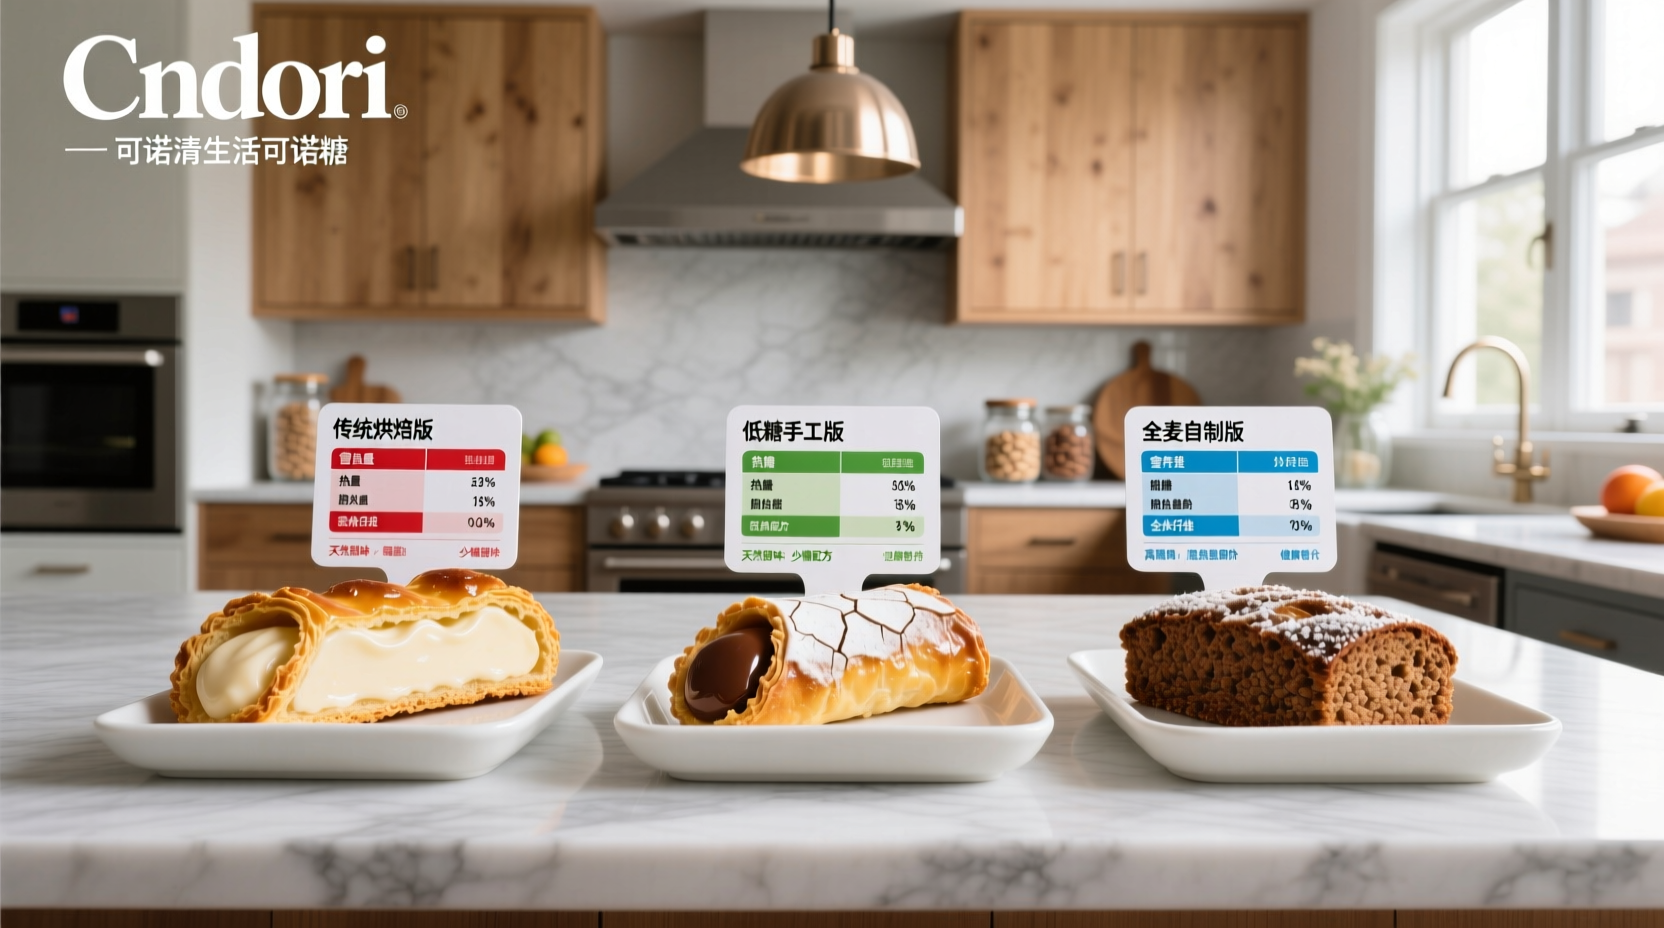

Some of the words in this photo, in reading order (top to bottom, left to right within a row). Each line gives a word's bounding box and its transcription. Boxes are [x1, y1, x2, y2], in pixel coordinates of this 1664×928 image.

[333, 417, 434, 441] 传统烘焙版
[742, 418, 845, 443] 低糖手工版
[1142, 420, 1245, 443] 全麦自制版
